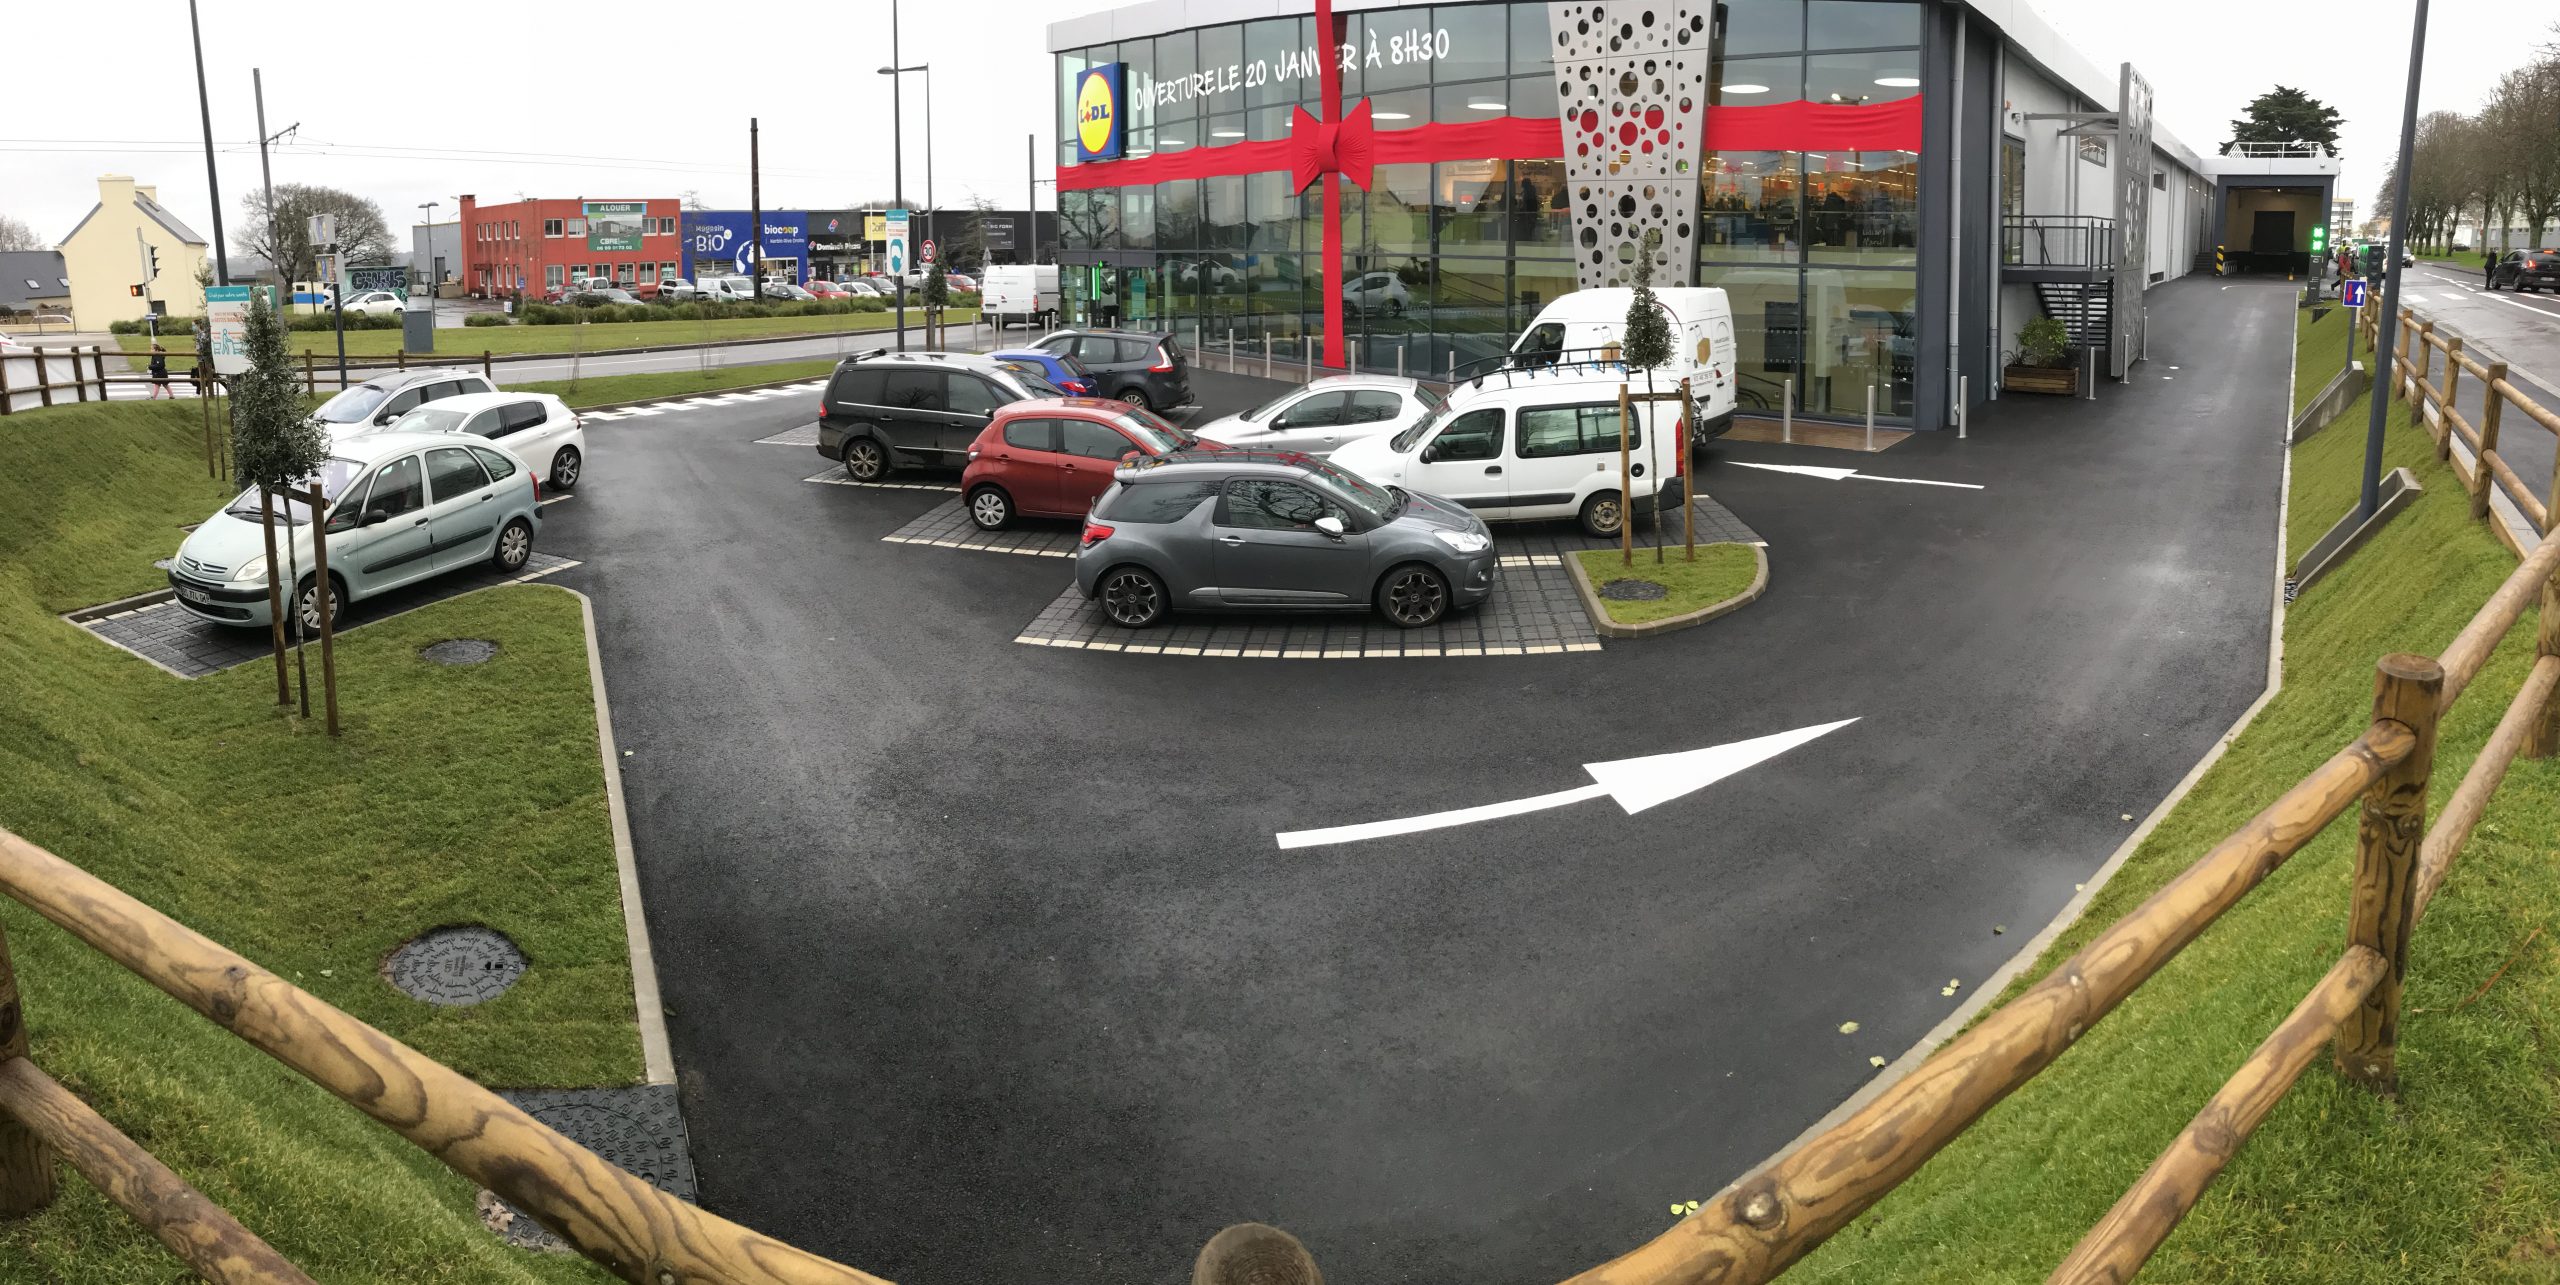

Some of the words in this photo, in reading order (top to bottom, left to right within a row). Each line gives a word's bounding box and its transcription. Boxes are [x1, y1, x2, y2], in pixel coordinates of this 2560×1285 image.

[1135, 70, 1216, 111] OUVERTURE
[1218, 64, 1241, 93] LE
[1245, 59, 1267, 88] 20
[1365, 28, 1383, 69] À
[1390, 28, 1450, 65] 8H30
[696, 224, 724, 234] Magasin
[764, 223, 799, 237] biocoop
[816, 242, 844, 251] Domino's
[924, 246, 932, 257] 30
